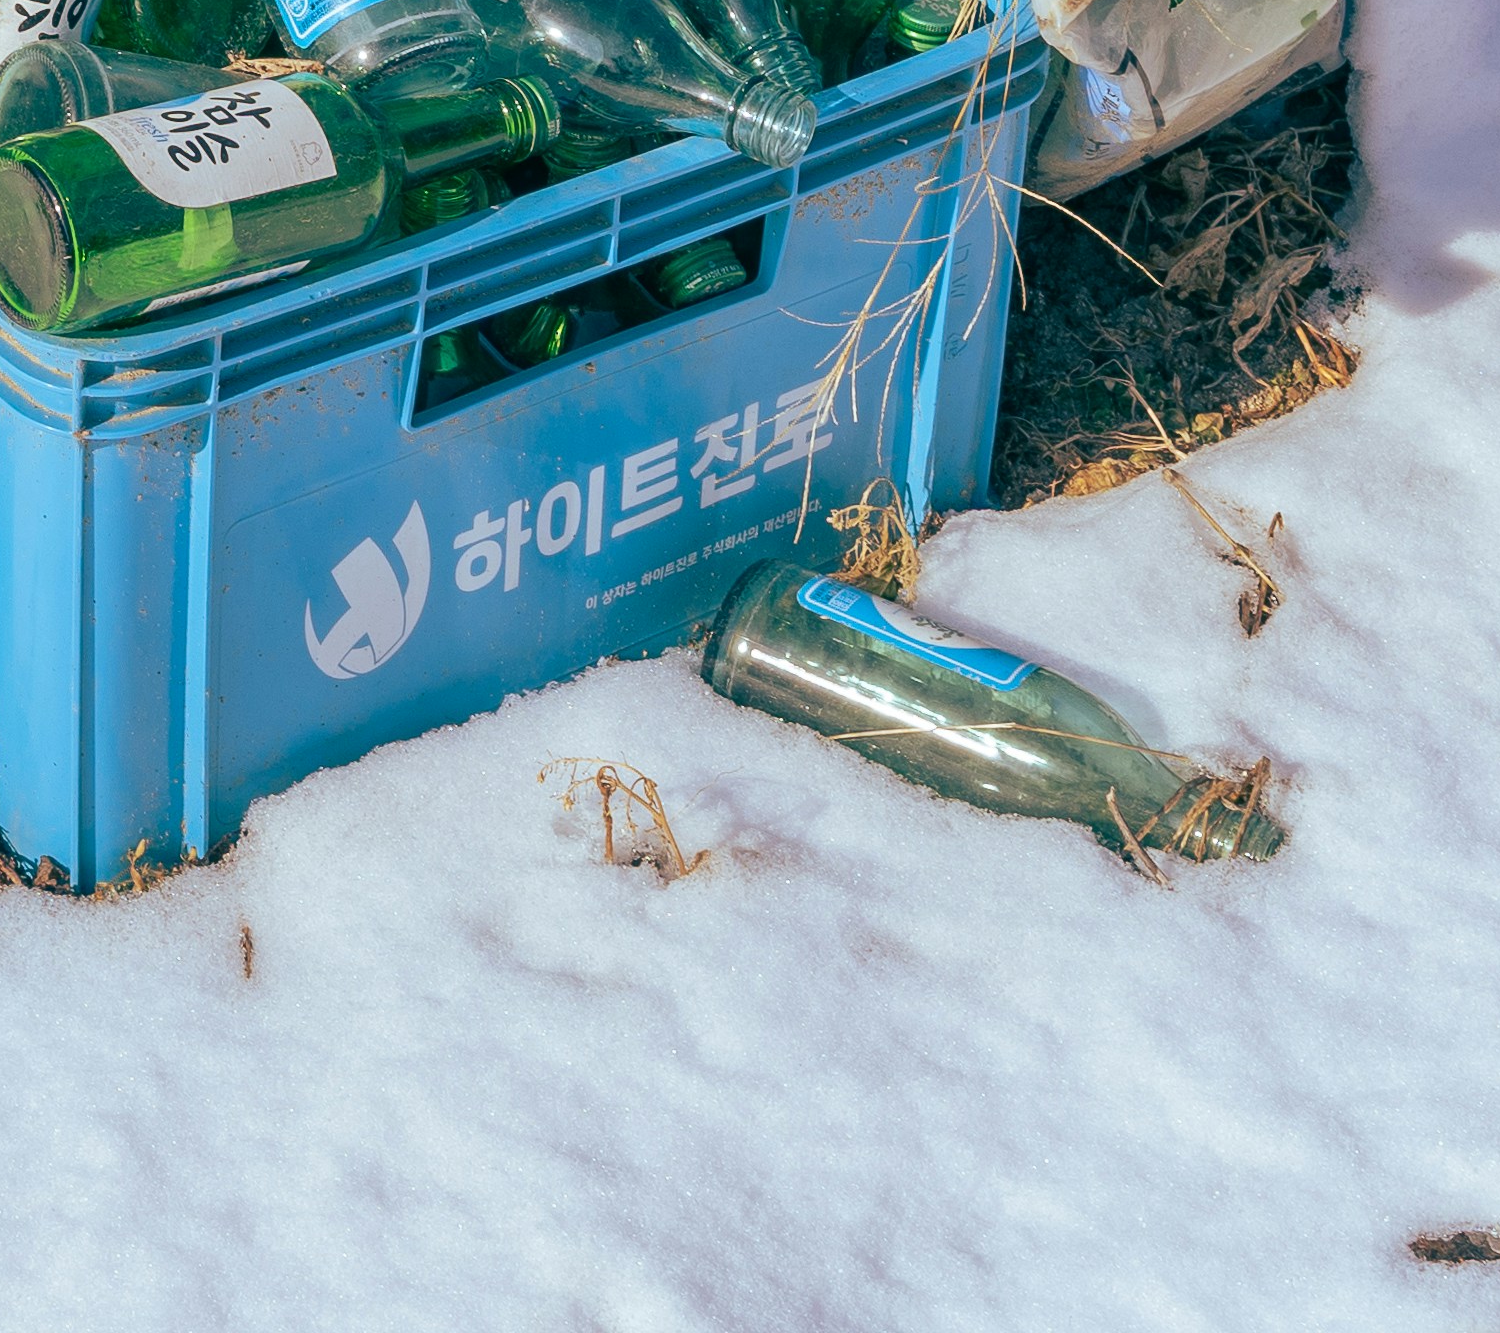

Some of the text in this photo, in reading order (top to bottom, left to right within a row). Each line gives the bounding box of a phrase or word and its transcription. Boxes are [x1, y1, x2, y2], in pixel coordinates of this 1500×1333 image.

[453, 379, 834, 593] 하이트진로
[585, 594, 598, 611] 이
[602, 581, 638, 608] 상자는
[640, 551, 698, 587] 하이트진로
[701, 524, 759, 560] 주식회사의
